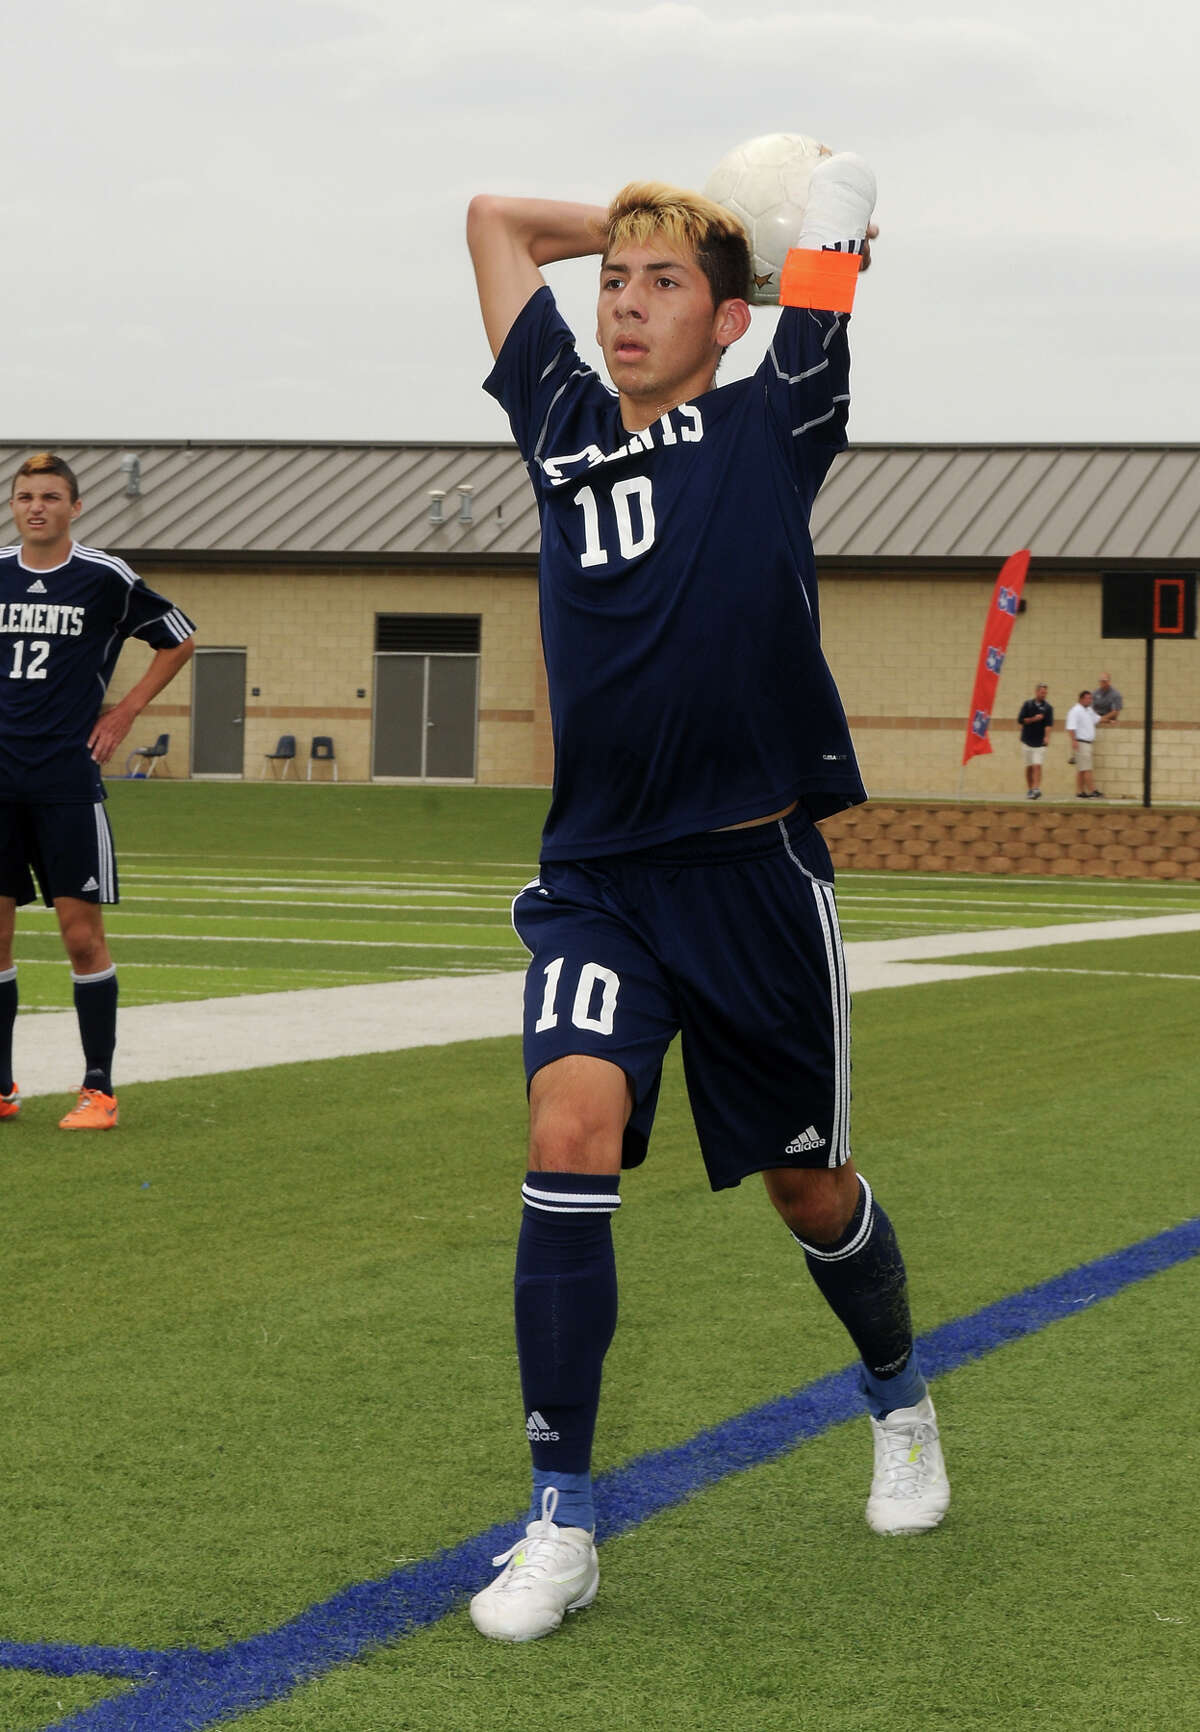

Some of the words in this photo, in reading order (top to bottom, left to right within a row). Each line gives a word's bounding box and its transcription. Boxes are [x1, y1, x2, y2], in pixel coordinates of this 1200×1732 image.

[573, 476, 655, 568] 10
[9, 640, 50, 680] 12
[535, 957, 620, 1036] 10
[785, 1138, 826, 1154] adidas
